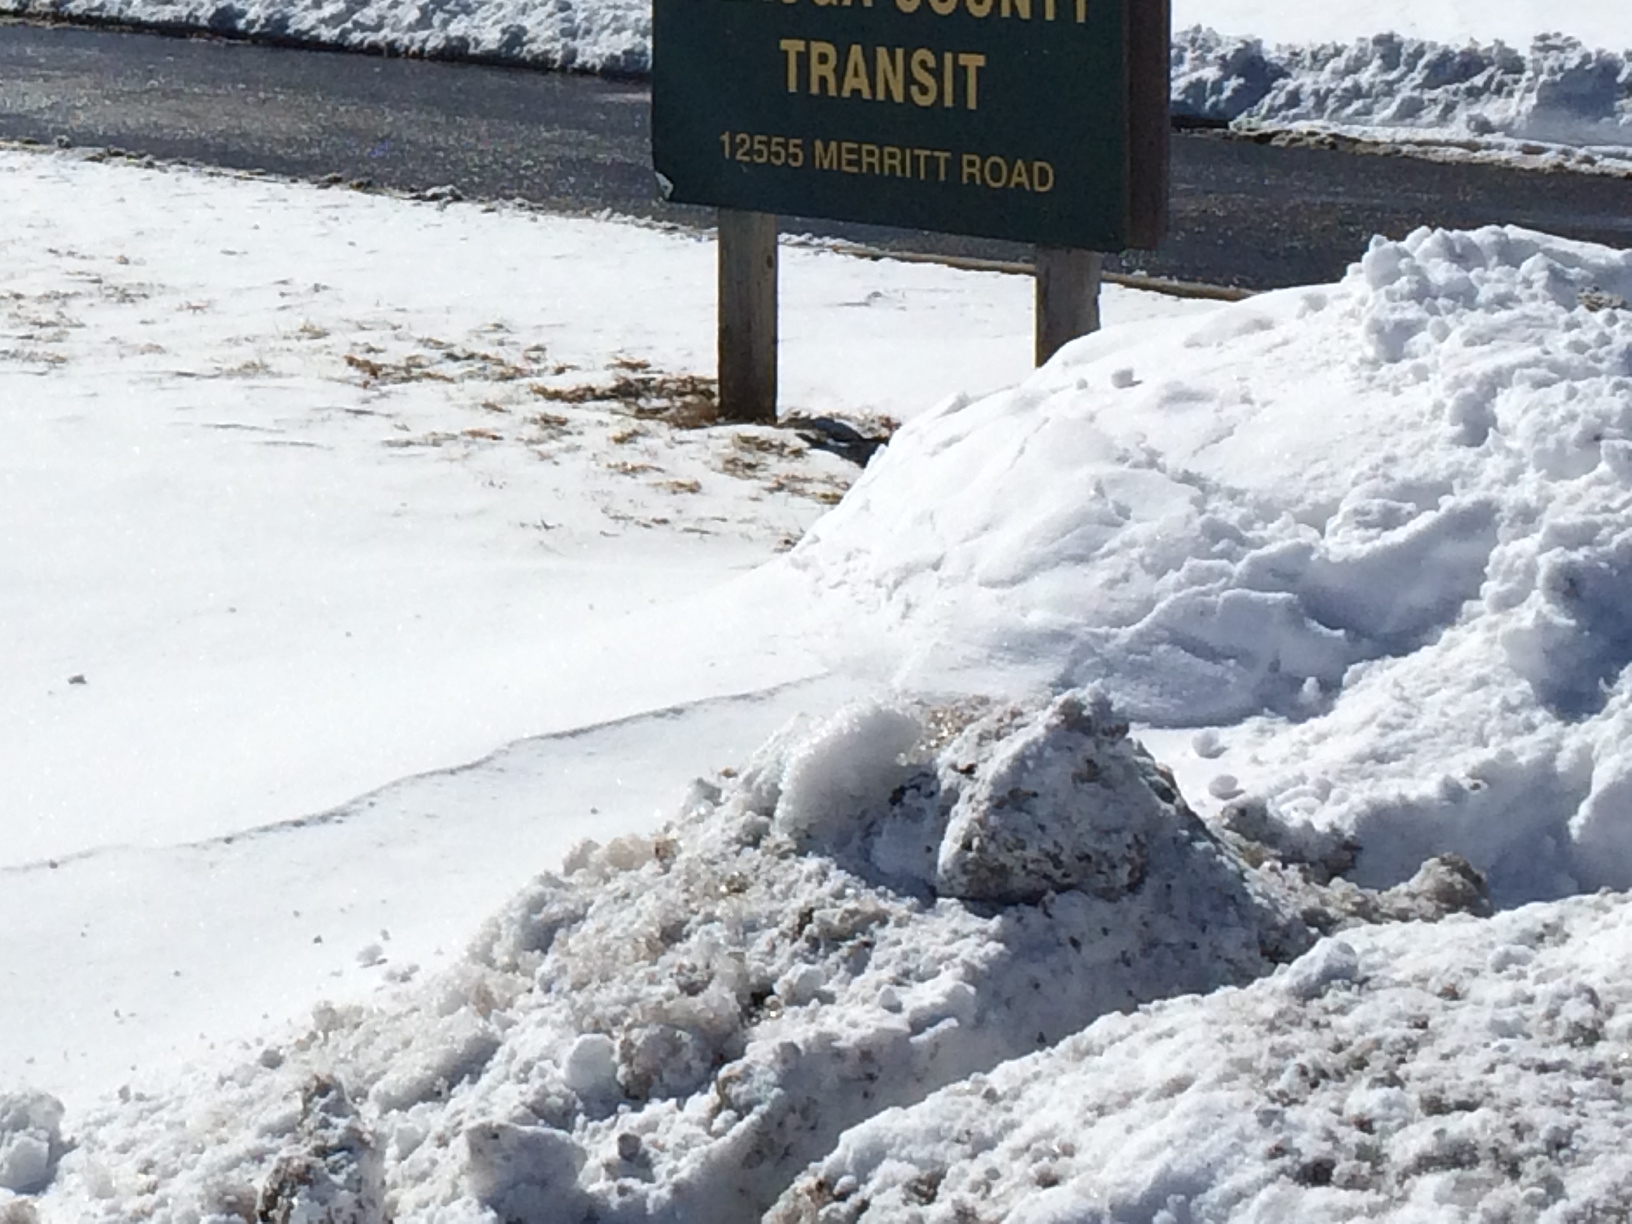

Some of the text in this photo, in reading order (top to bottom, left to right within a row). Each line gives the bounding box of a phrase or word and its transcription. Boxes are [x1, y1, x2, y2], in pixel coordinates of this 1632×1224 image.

[780, 39, 986, 110] TRANSIT
[719, 131, 1055, 193] 12555 MERRITT ROAD
